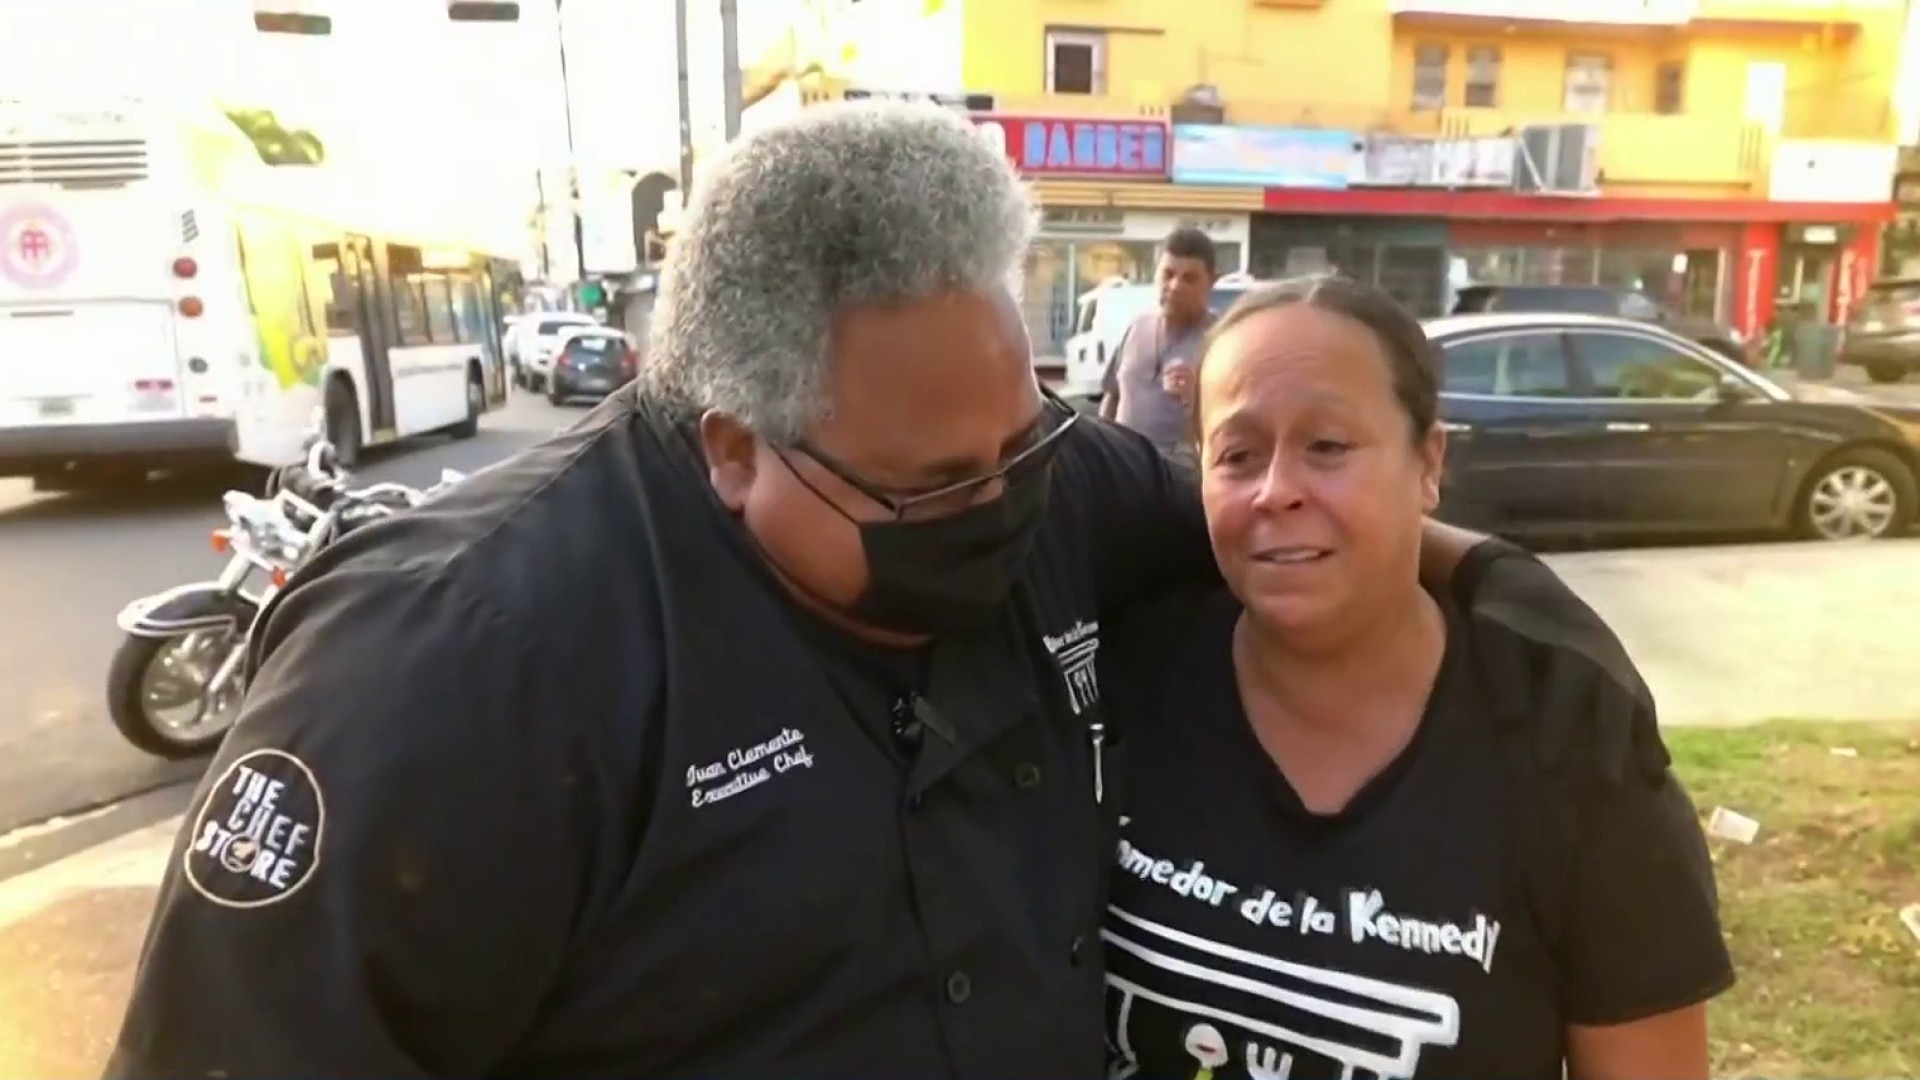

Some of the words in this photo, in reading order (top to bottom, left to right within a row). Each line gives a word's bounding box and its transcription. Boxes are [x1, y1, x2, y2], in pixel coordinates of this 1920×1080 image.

[232, 764, 286, 810] THE
[686, 761, 727, 787] Juan
[727, 727, 804, 770] Clemente
[691, 767, 771, 808] Executive
[773, 744, 814, 773] Chef
[195, 820, 297, 889] STORE
[227, 796, 310, 856] CHEF
[1116, 816, 1238, 907] omedor
[1240, 888, 1292, 926] de
[1299, 895, 1336, 936] la
[1348, 887, 1501, 975] Kennedy
